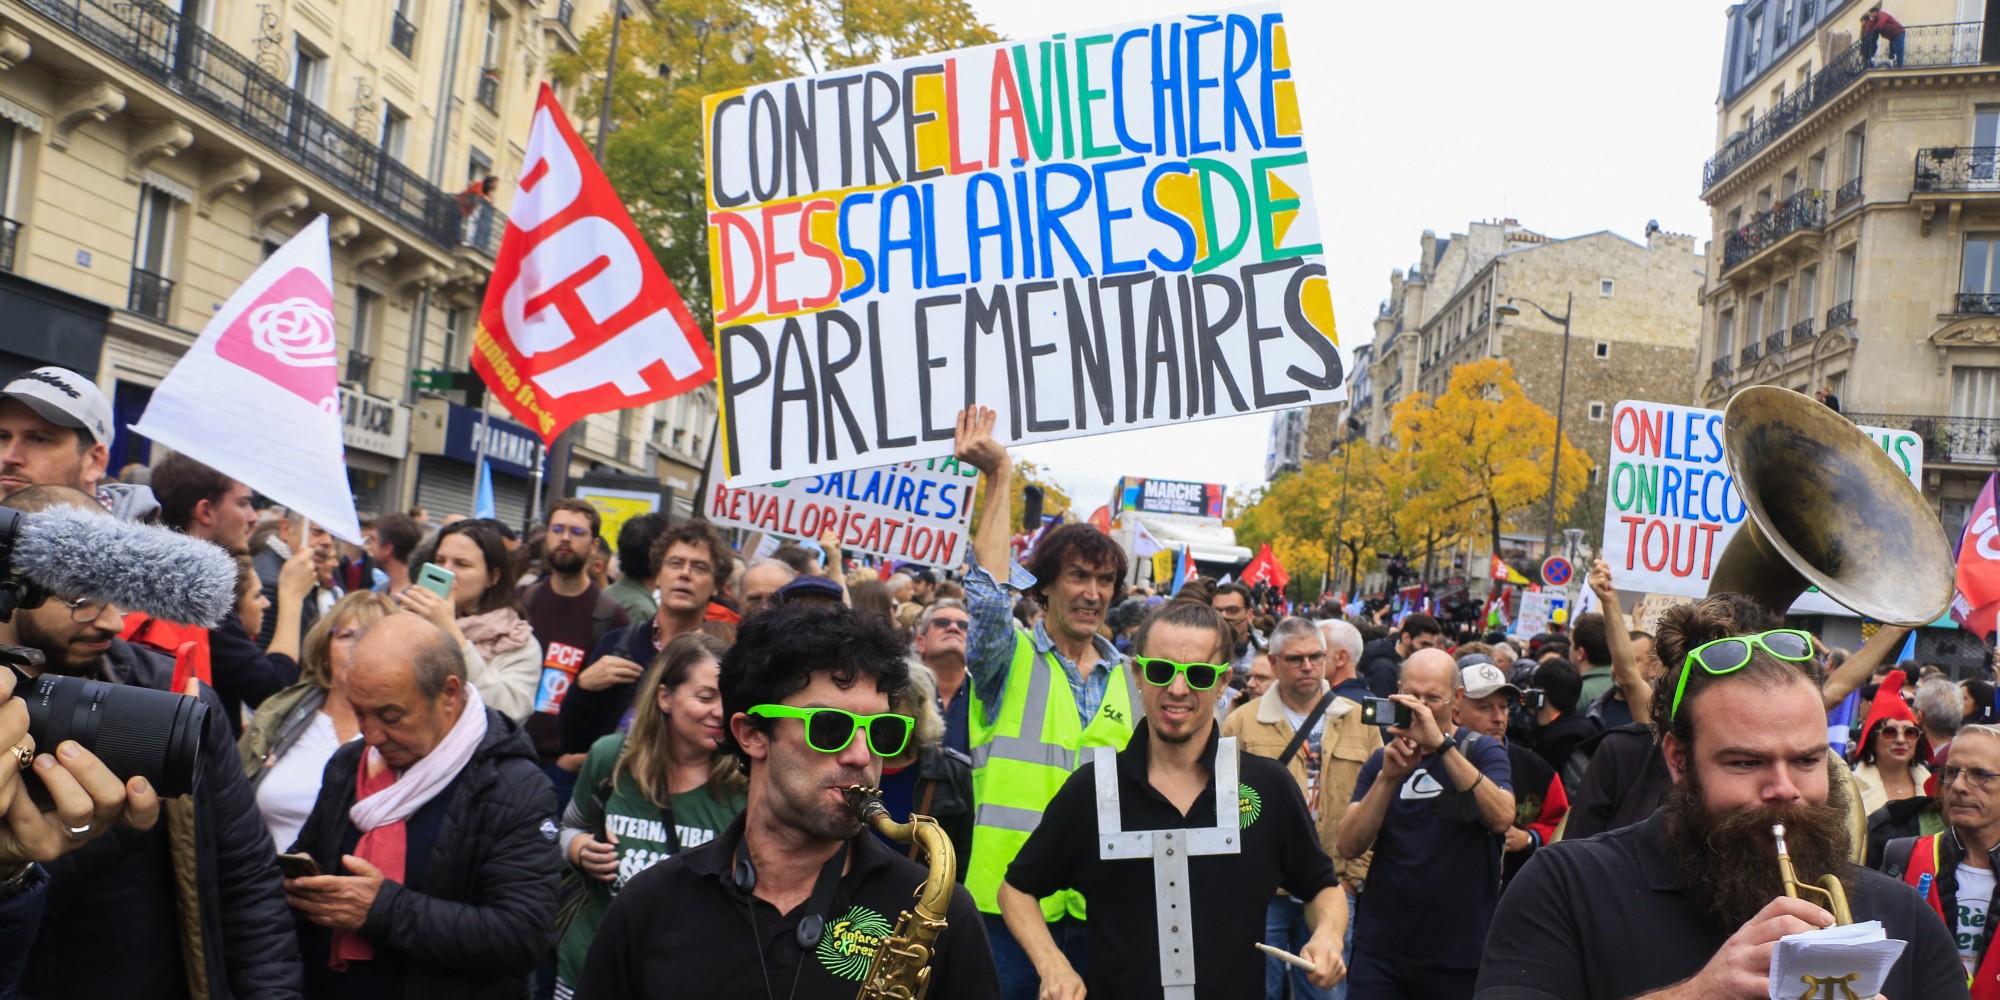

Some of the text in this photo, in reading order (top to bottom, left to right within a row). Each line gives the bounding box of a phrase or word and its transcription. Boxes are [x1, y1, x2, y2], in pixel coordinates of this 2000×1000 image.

[712, 13, 1303, 208] CONTRE LA VIE CHÈRE
[502, 104, 704, 400] PCF
[710, 152, 1323, 323] DES SALAIRES DE
[720, 257, 1344, 477] PARLEMENTAIRES
[471, 421, 547, 472] PHARMACE
[1613, 406, 1725, 464] ON LES
[1144, 480, 1203, 503] MARCHE
[1611, 461, 1747, 525] ON RECO
[712, 483, 959, 565] REVALORISATION
[1620, 516, 1723, 580] TOUT
[545, 642, 585, 667] PCF
[833, 921, 879, 947] Fanfare
